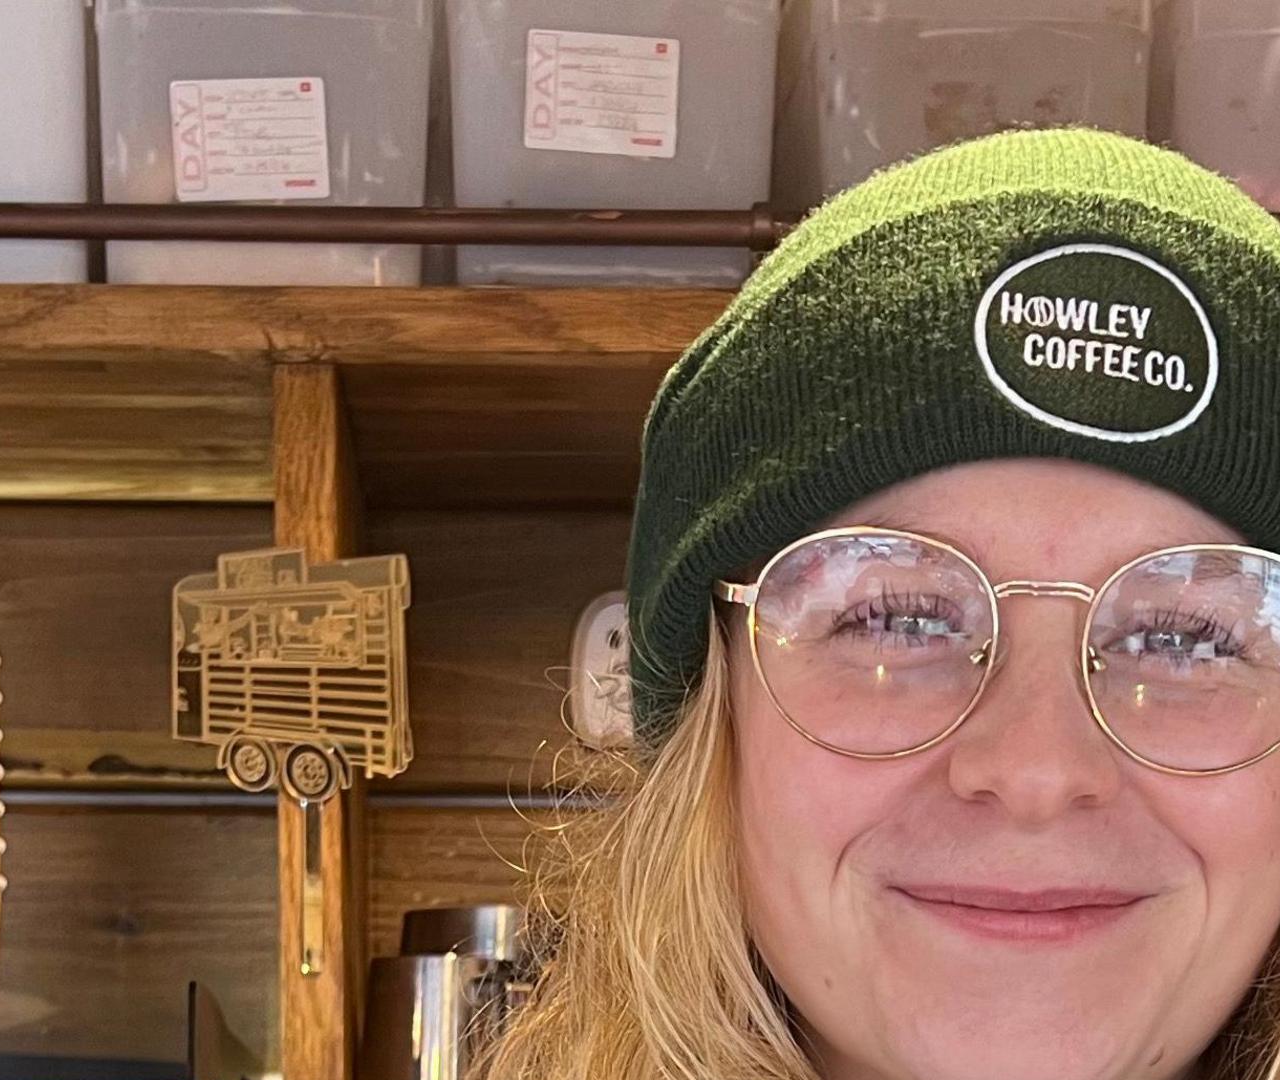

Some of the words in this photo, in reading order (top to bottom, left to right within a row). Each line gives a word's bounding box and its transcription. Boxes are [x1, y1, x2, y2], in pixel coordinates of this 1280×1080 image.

[532, 48, 554, 129] DAY
[177, 99, 201, 181] DAY
[1001, 291, 1152, 340] HOWLEY
[1023, 333, 1142, 382] COFFEE
[1144, 350, 1194, 393] CO.
